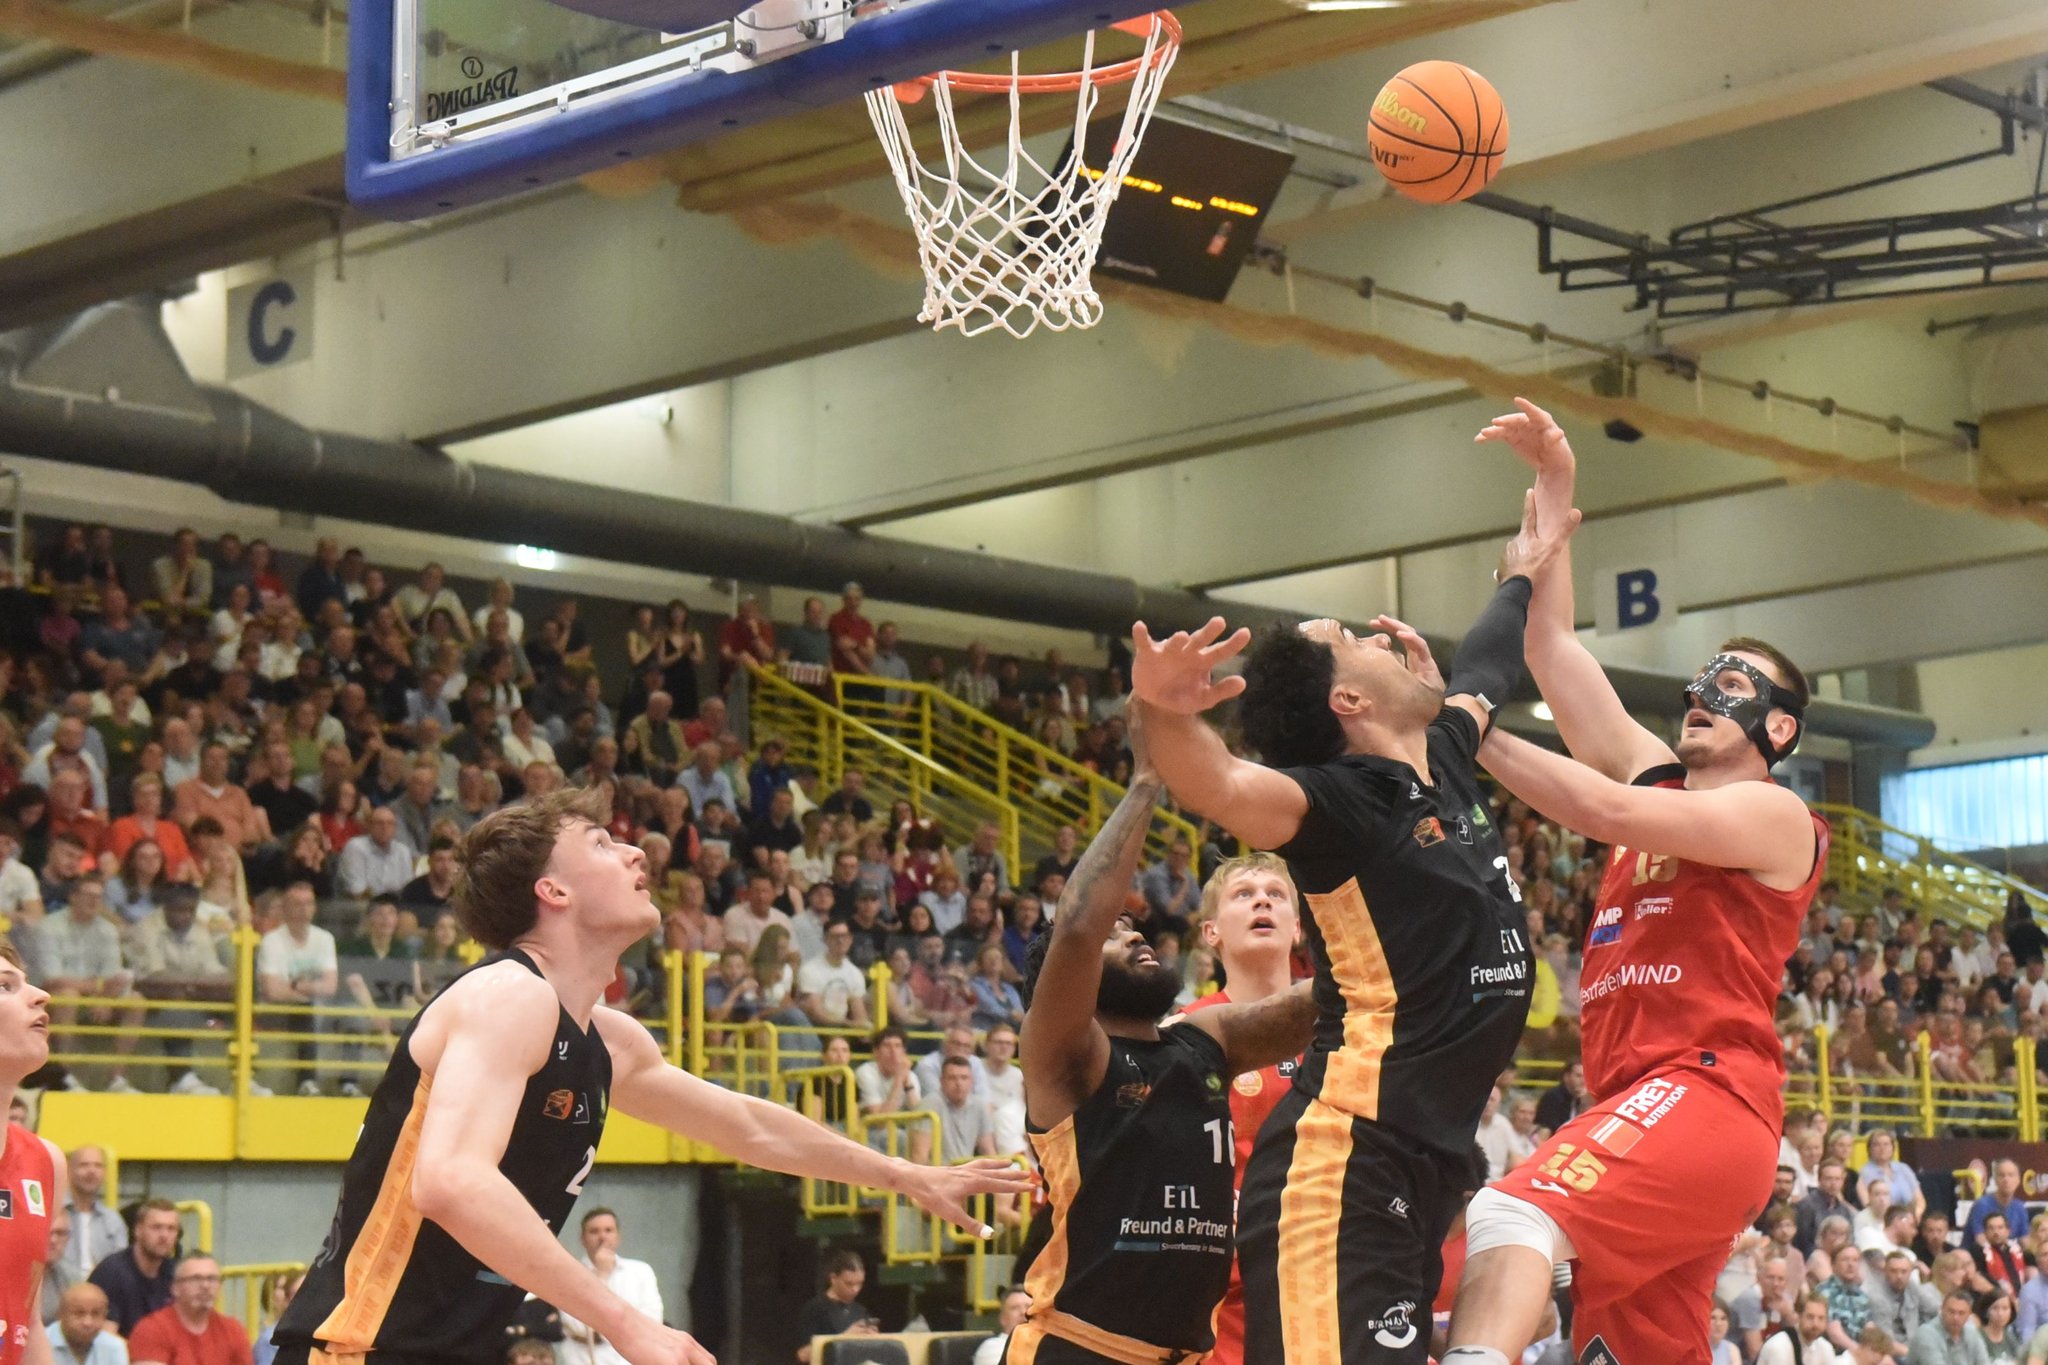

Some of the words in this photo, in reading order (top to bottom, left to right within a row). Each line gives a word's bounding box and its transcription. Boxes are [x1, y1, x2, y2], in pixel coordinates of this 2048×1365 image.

[1375, 87, 1426, 135] ilson
[247, 280, 297, 365] C
[1616, 568, 1660, 629] B
[1470, 961, 1514, 985] Freund
[1514, 963, 1522, 979] &
[1580, 963, 1682, 1009] estfalenWIND
[1614, 1077, 1674, 1122] FREY
[1641, 1084, 1689, 1129] NUTRITION
[1537, 1142, 1608, 1193] 15
[1163, 1184, 1201, 1209] ETL
[1119, 1215, 1172, 1236] Freund
[1174, 1218, 1186, 1235] &
[1187, 1216, 1228, 1238] Partner
